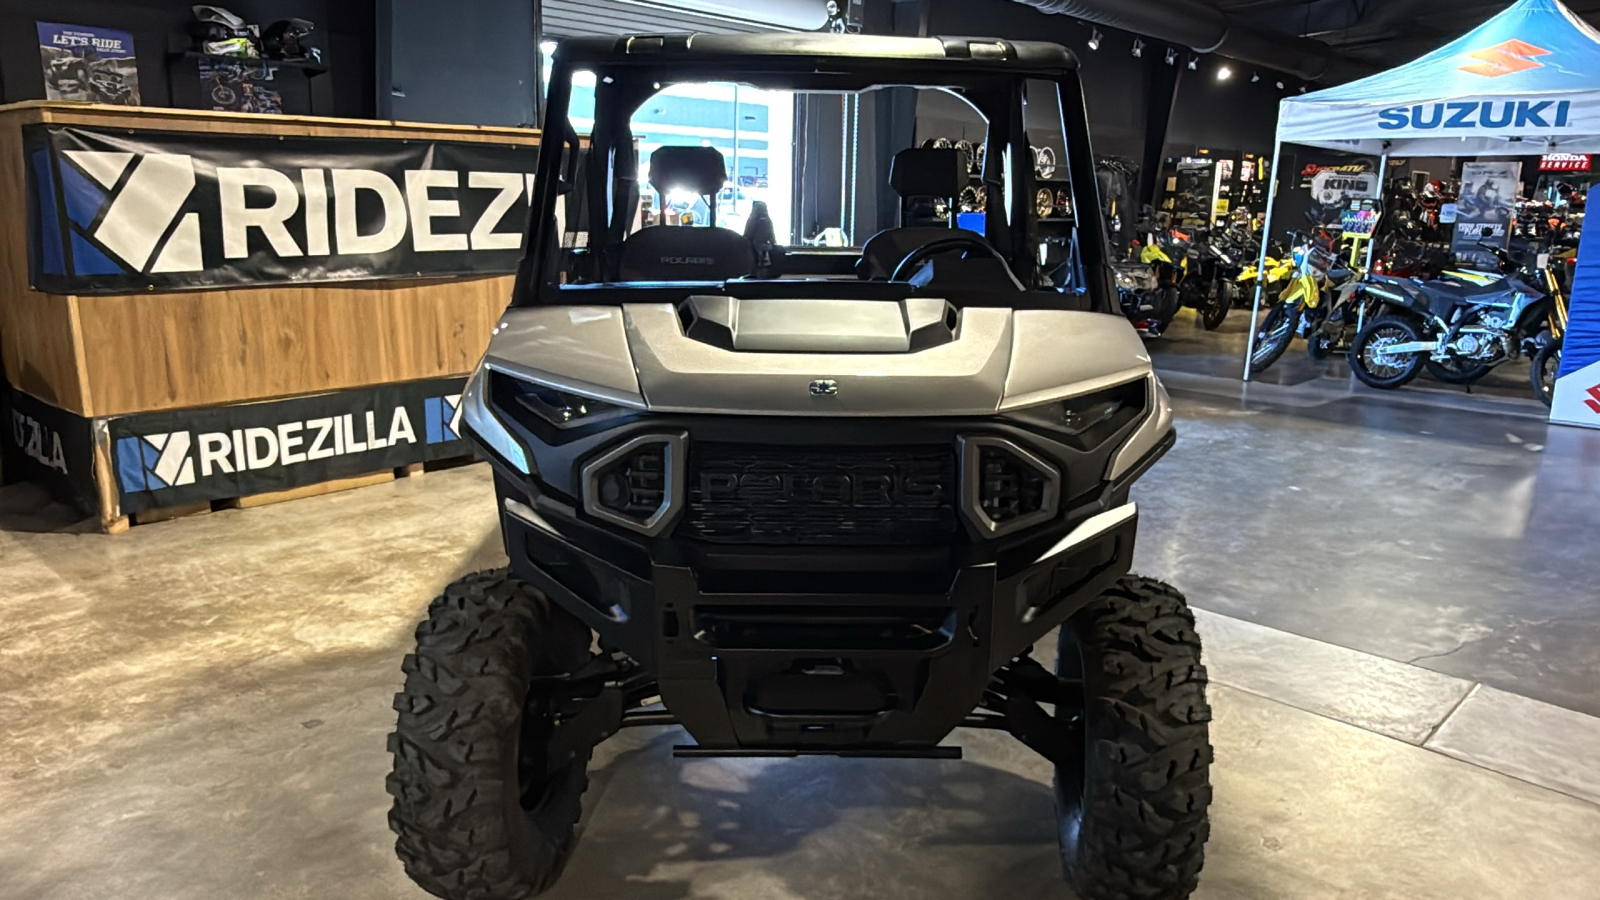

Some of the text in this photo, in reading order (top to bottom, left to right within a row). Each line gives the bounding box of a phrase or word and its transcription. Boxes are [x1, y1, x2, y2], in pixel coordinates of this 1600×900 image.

[53, 34, 89, 47] LET'S
[92, 37, 122, 49] RIDE
[1378, 100, 1571, 130] SUZUKI
[1541, 153, 1588, 161] HONDA
[1540, 161, 1588, 169] SERVICE
[198, 405, 417, 477] RIDEZILLA
